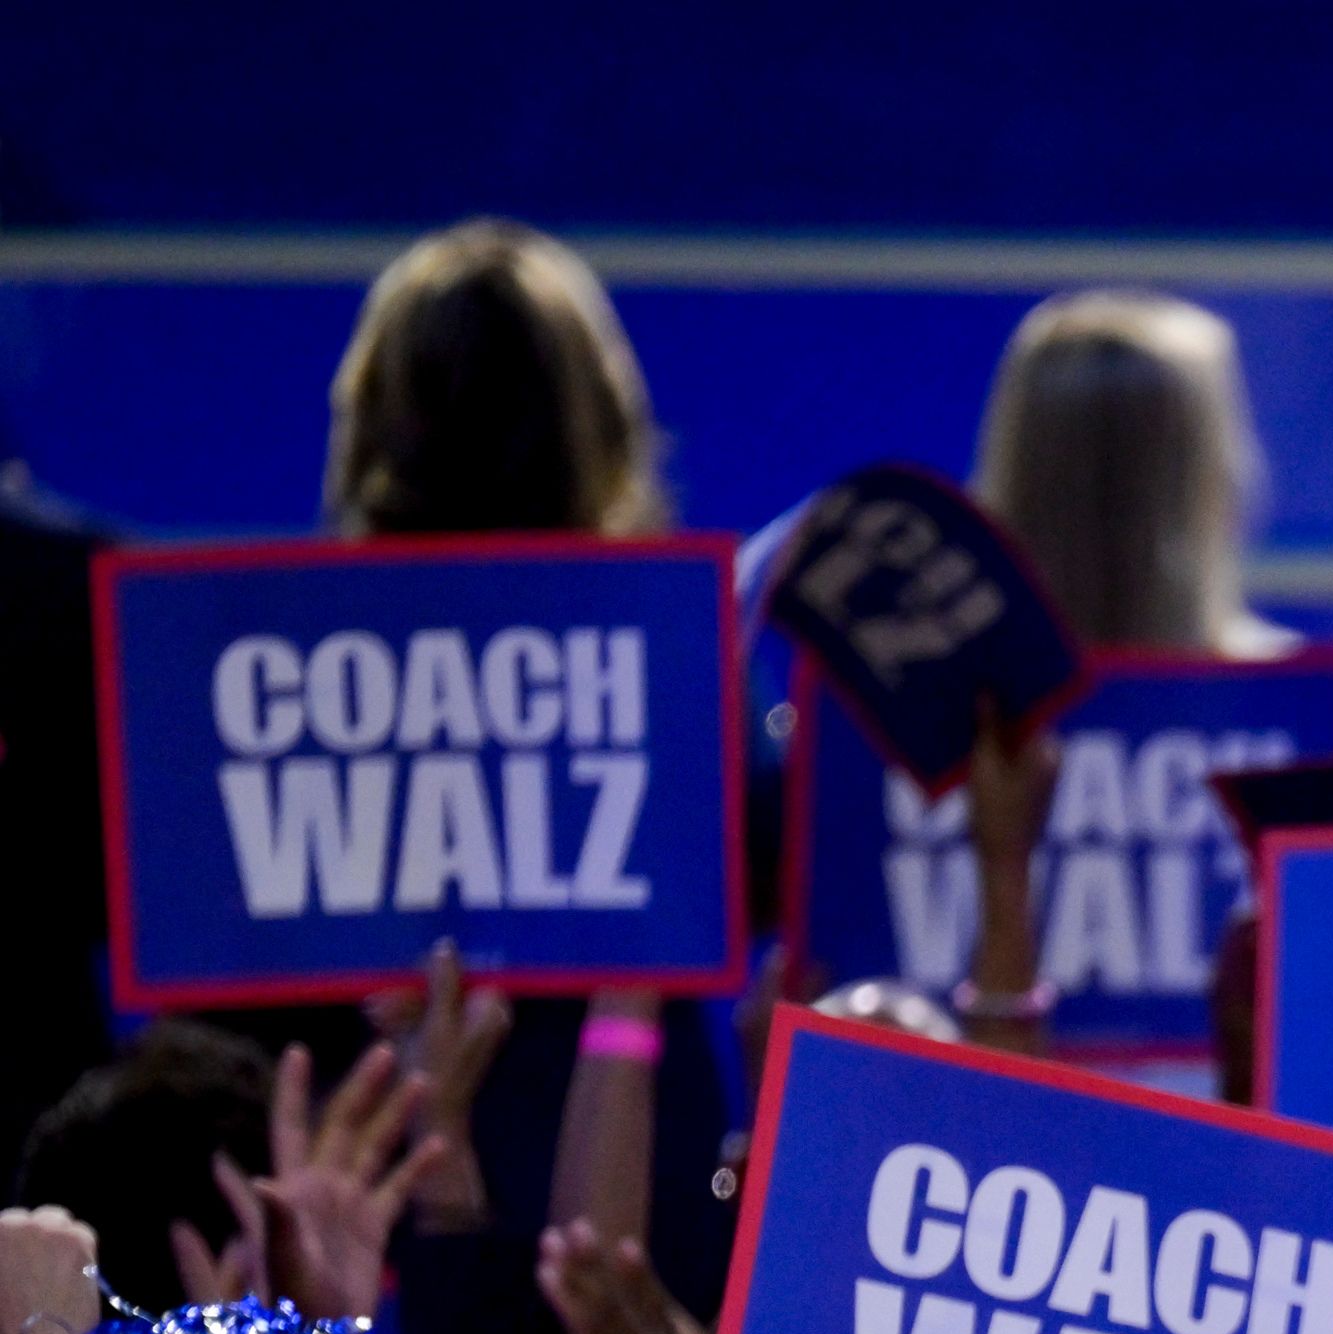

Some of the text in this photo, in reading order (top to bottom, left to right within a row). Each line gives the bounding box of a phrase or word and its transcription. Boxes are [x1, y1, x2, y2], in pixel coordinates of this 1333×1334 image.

[212, 627, 648, 757] COACH
[217, 752, 650, 921] WALZ
[881, 845, 1262, 993] WAL
